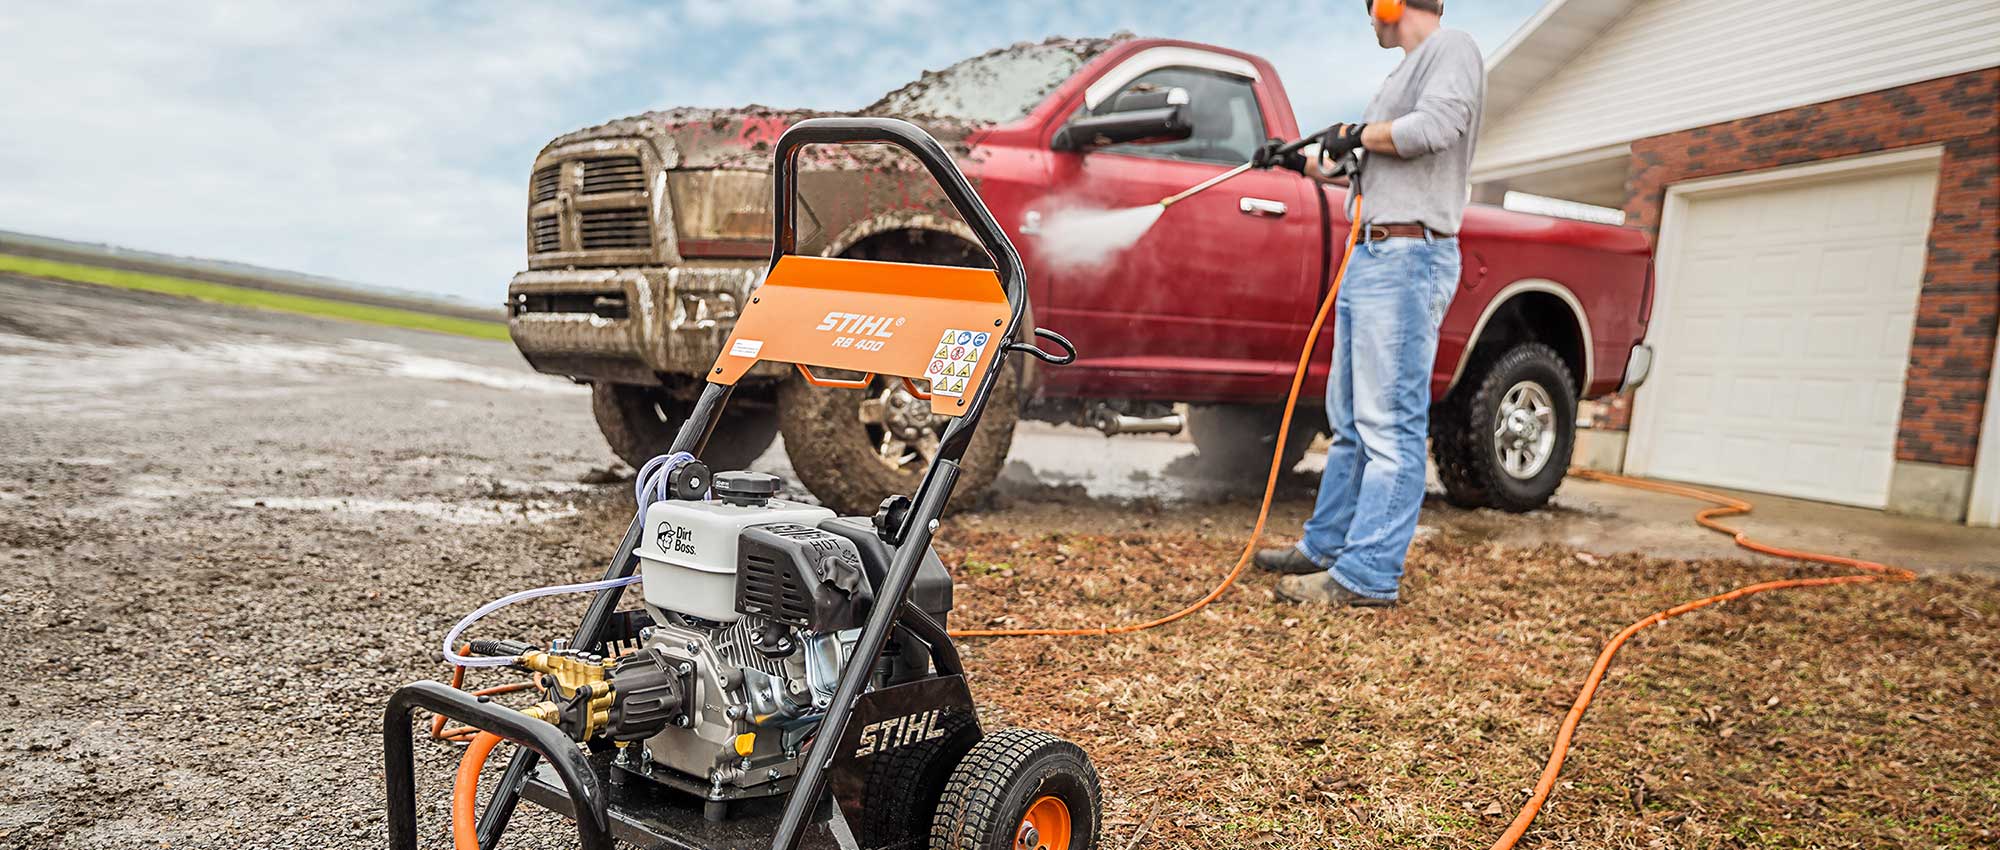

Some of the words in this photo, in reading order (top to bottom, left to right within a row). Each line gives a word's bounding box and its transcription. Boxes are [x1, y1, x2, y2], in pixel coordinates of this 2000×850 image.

[831, 336, 855, 348] RB
[854, 339, 885, 352] 400
[676, 526, 691, 541] Dirt
[809, 539, 840, 552] HOT
